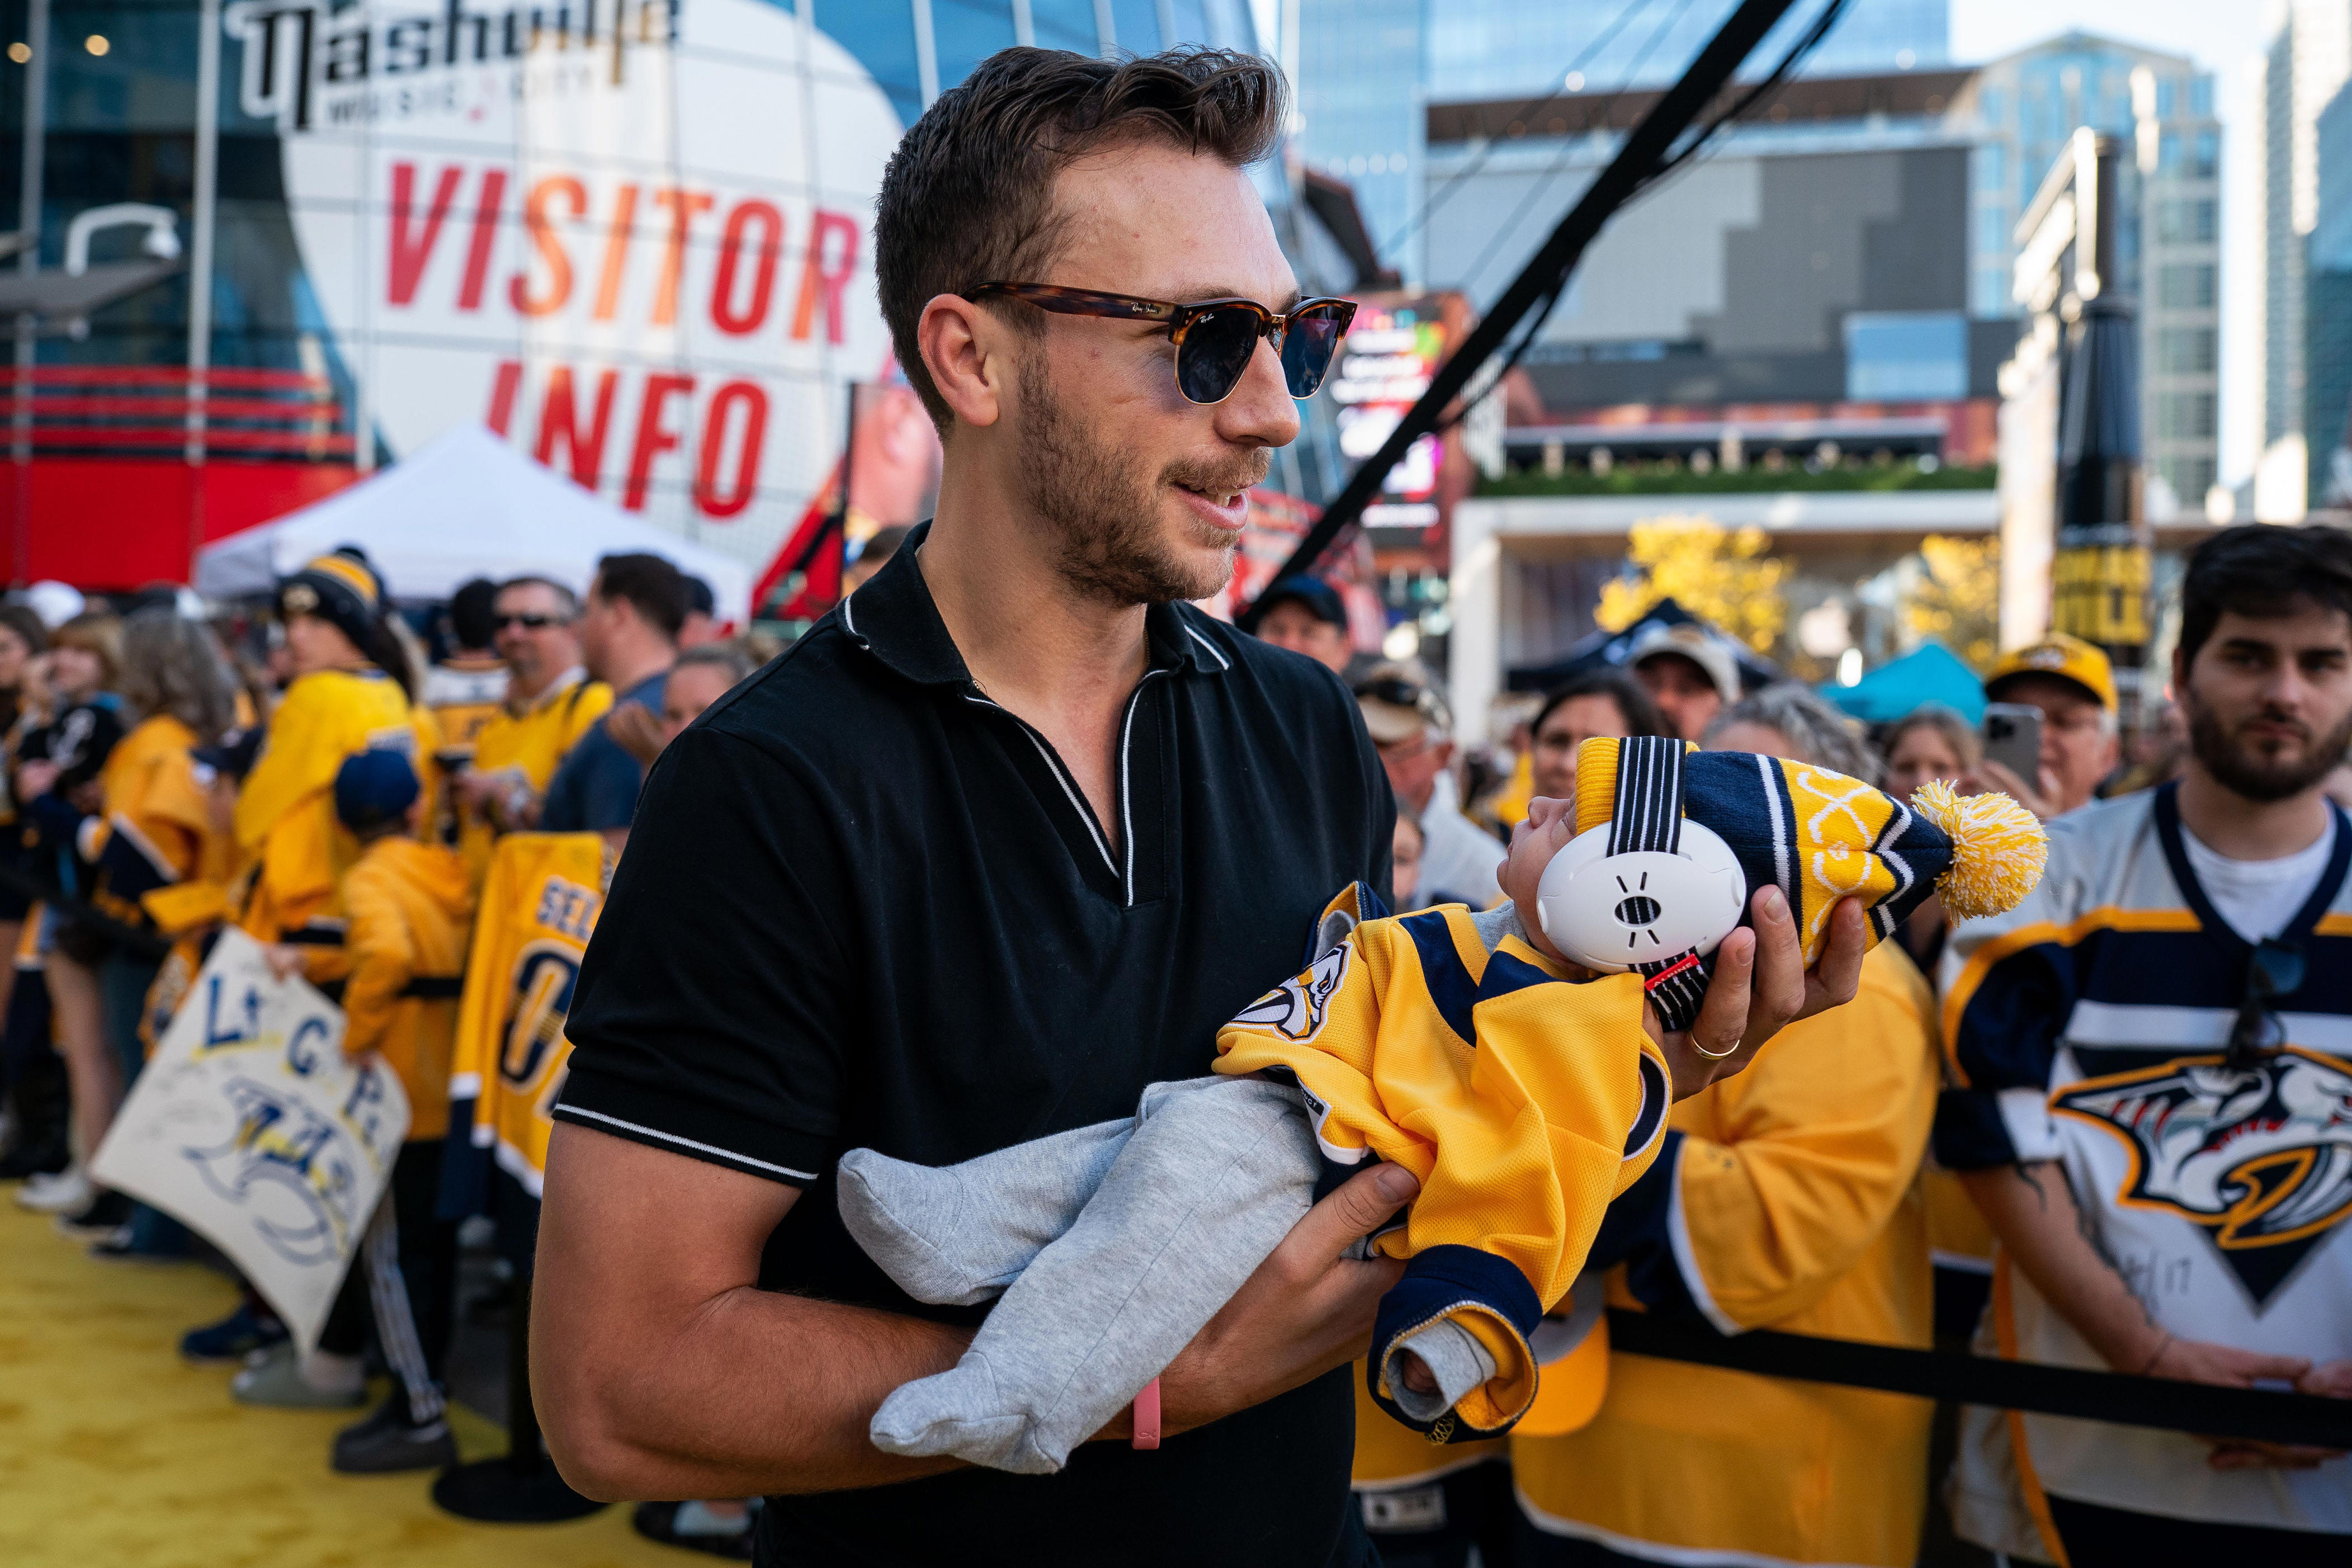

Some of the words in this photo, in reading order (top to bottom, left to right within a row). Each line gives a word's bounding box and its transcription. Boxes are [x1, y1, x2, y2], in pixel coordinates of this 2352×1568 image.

[386, 158, 862, 344] VISITOR
[484, 359, 771, 521] INFO
[1654, 962, 1693, 988] ALPINE
[1301, 1088, 1318, 1109] UCT
